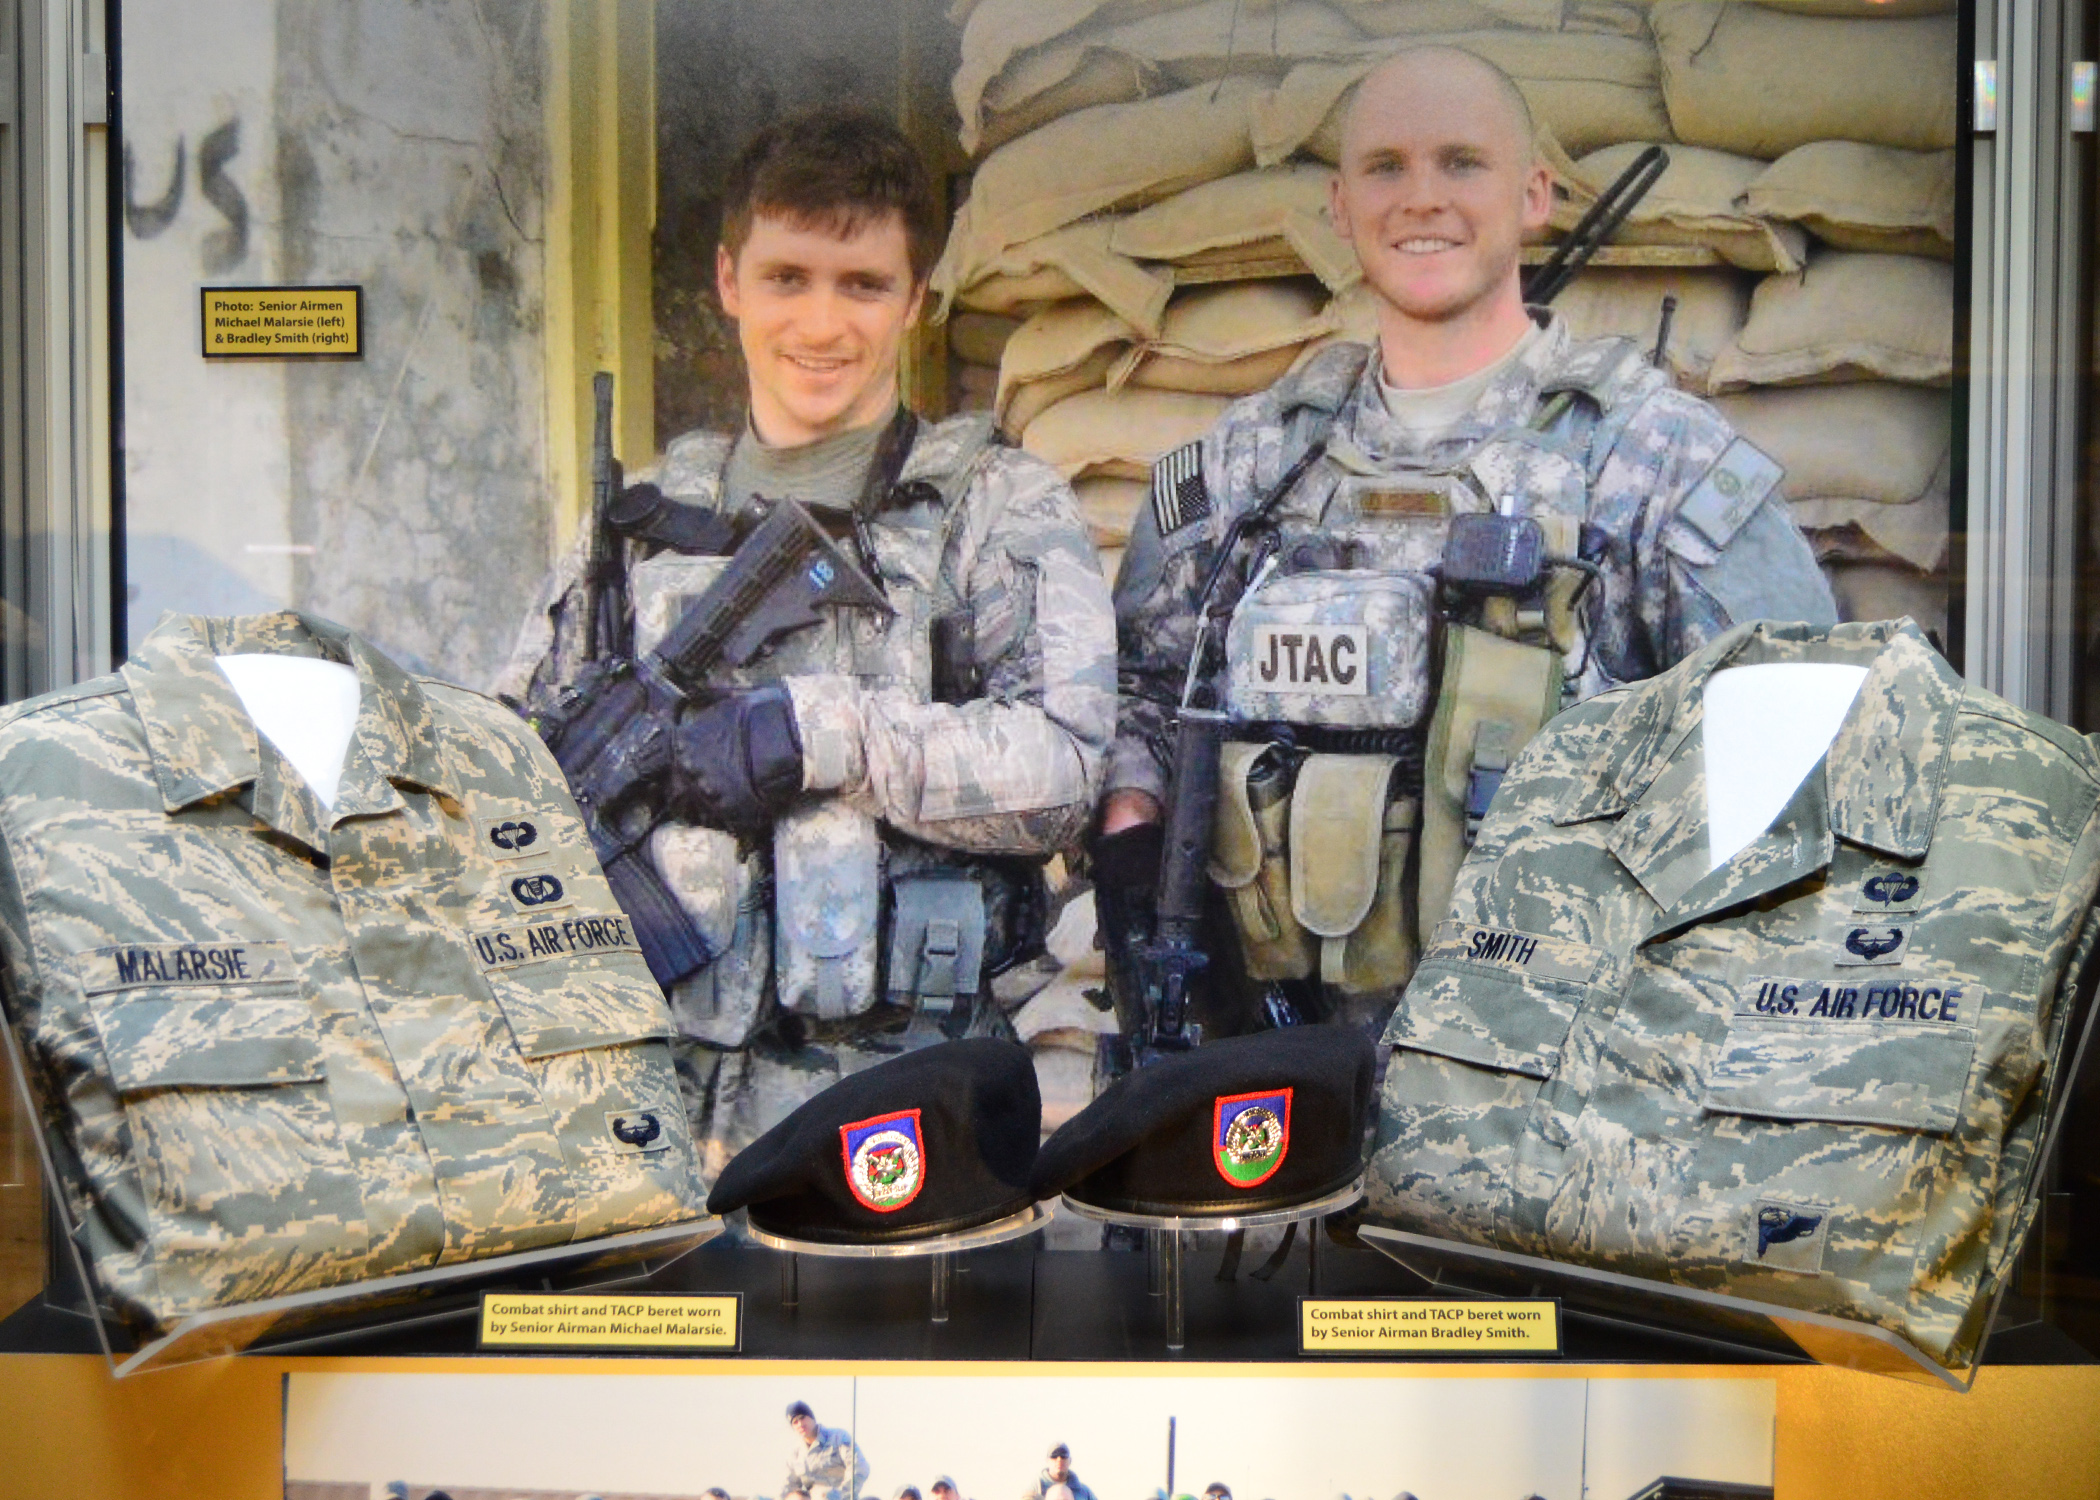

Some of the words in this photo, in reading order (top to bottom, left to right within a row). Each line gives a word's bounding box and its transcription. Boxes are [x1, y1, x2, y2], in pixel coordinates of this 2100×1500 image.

[214, 301, 254, 312] Photo:
[259, 300, 297, 311] Senior
[300, 300, 343, 311] Airmen
[215, 317, 261, 327] Michael
[264, 317, 314, 327] Malarsie
[316, 316, 345, 328] (left)
[215, 333, 224, 344] &
[227, 333, 272, 345] Bradley
[275, 333, 309, 343] Smith
[312, 332, 349, 345] (right)
[1260, 633, 1357, 684] JTAC
[475, 932, 525, 965] U.S.
[527, 925, 564, 957] AIR
[562, 917, 632, 950] FORCE
[1467, 930, 1539, 965] SMITH
[114, 948, 252, 983] MALARSIE
[1755, 982, 1799, 1016] U.S.
[1808, 987, 1858, 1018] AIR
[1862, 986, 1963, 1022] FORCE
[491, 1303, 544, 1315] Combat
[547, 1304, 579, 1315] shirt
[581, 1304, 607, 1315] and
[610, 1305, 644, 1316] TACP
[648, 1305, 684, 1316] beret
[687, 1308, 721, 1316] worn
[1310, 1308, 1364, 1320] Combat
[1367, 1308, 1398, 1320] shirt
[1401, 1309, 1427, 1320] and
[1429, 1309, 1464, 1320] TACP
[1467, 1309, 1504, 1320] beret
[1507, 1311, 1541, 1320] worn
[490, 1321, 507, 1335] by
[510, 1321, 554, 1333] Senior
[557, 1322, 606, 1333] Airman
[610, 1323, 662, 1334] Michael
[666, 1323, 727, 1335] Malarsie.
[1311, 1326, 1328, 1340] by
[1331, 1326, 1375, 1338] Senior
[1378, 1326, 1428, 1338] Airman
[1431, 1326, 1483, 1341] Bradley
[1486, 1326, 1530, 1338] Smith.
